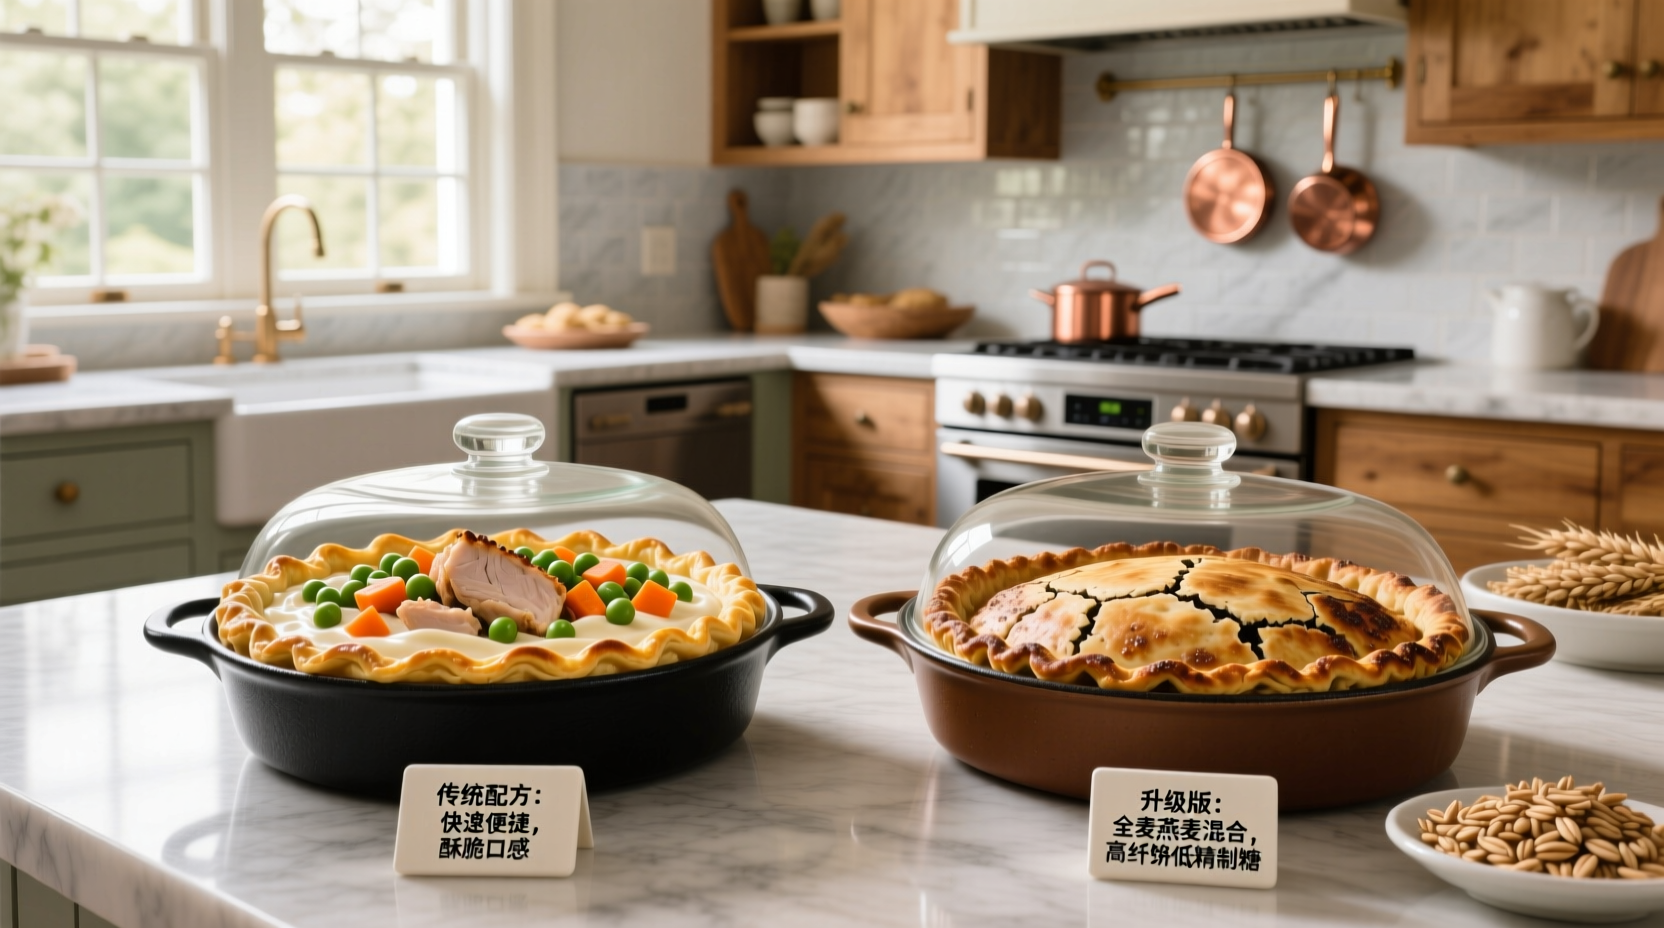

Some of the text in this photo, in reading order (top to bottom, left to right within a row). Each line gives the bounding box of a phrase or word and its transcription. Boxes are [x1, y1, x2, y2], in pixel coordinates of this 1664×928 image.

[437, 782, 541, 806] 传统配方：
[1140, 789, 1221, 814] 升级版：
[1113, 815, 1257, 846] 全麦燕麦混合，
[438, 837, 530, 860] 酥脆口感
